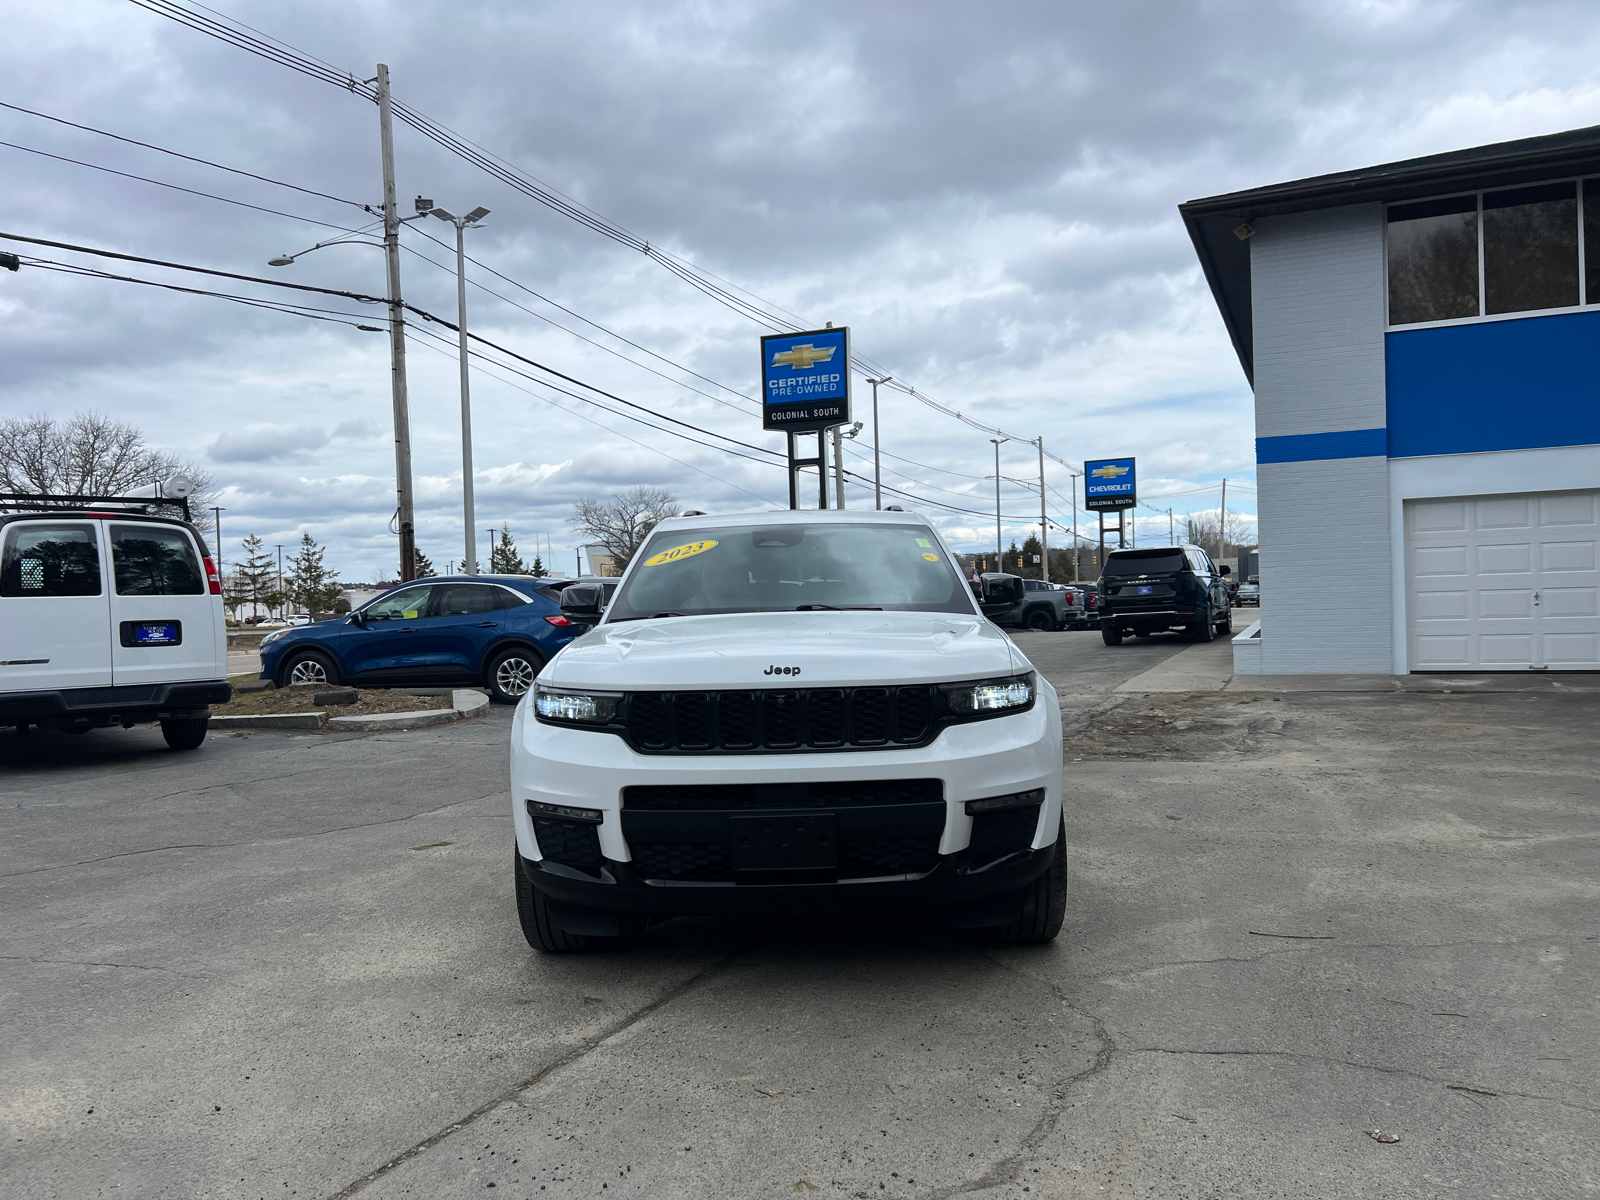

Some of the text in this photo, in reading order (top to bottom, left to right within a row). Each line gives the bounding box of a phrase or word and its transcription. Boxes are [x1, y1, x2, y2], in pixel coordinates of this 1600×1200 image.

[768, 373, 840, 388] CERTIFIED
[772, 383, 837, 396] PRE-OWNED
[771, 407, 839, 421] COLONIAL SOUTH
[1089, 483, 1132, 493] CHEVROLET
[656, 542, 705, 563] 2023
[763, 664, 802, 677] Jeep
